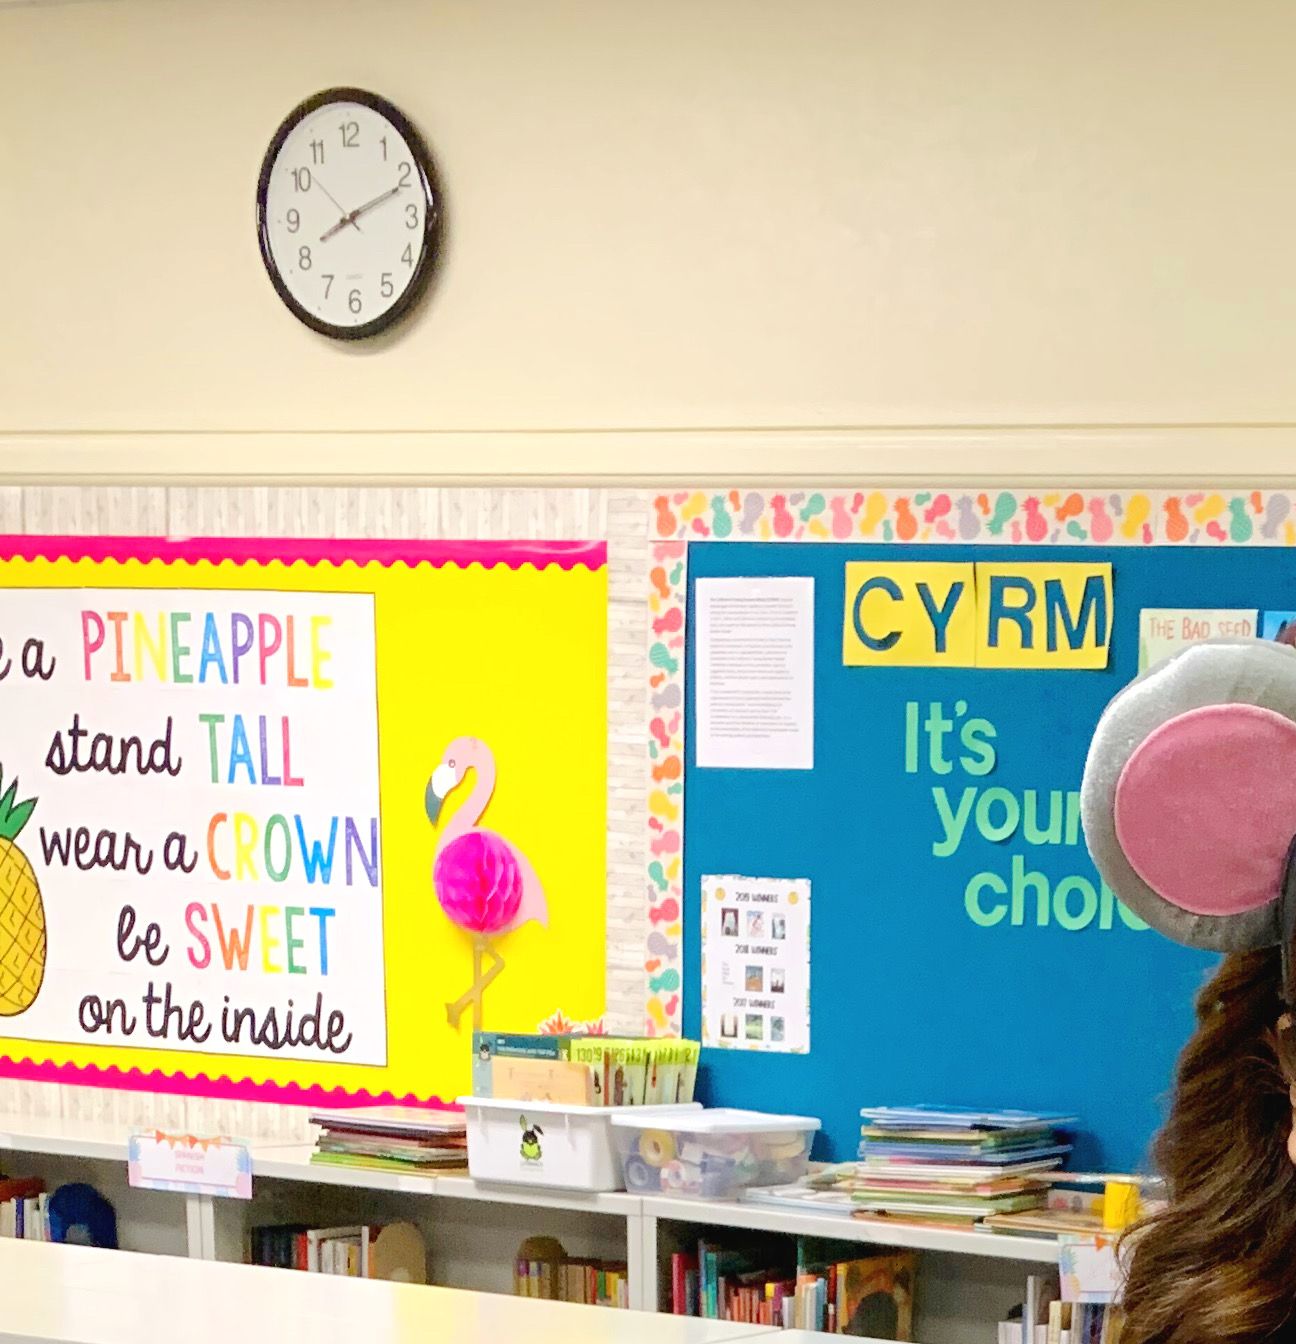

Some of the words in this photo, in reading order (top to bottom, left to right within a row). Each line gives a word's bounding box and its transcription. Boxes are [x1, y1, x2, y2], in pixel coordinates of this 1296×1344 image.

[338, 122, 360, 147] 12
[310, 139, 324, 164] 11
[379, 136, 387, 161] 1
[291, 167, 312, 192] 10
[398, 162, 412, 187] 2
[286, 209, 300, 233] 9
[405, 204, 418, 229] 3
[299, 246, 312, 270] 8
[401, 243, 413, 268] 4
[321, 275, 334, 299] 7
[381, 273, 394, 298] 5
[349, 289, 362, 314] 6
[852, 573, 1108, 654] CYRM
[1149, 618, 1175, 641] THE
[1182, 617, 1211, 641] BAD
[22, 638, 56, 680] a
[81, 610, 334, 689] PINEAPPLE
[46, 713, 182, 776] stand
[199, 714, 304, 786] TALL
[905, 700, 997, 776] It's
[39, 826, 153, 875] wear
[163, 832, 198, 873] a
[207, 811, 379, 887] CROWN
[117, 904, 169, 966] be
[185, 901, 336, 976] SWEET
[78, 995, 136, 1036] on
[143, 981, 212, 1042] the
[222, 992, 353, 1054] inside
